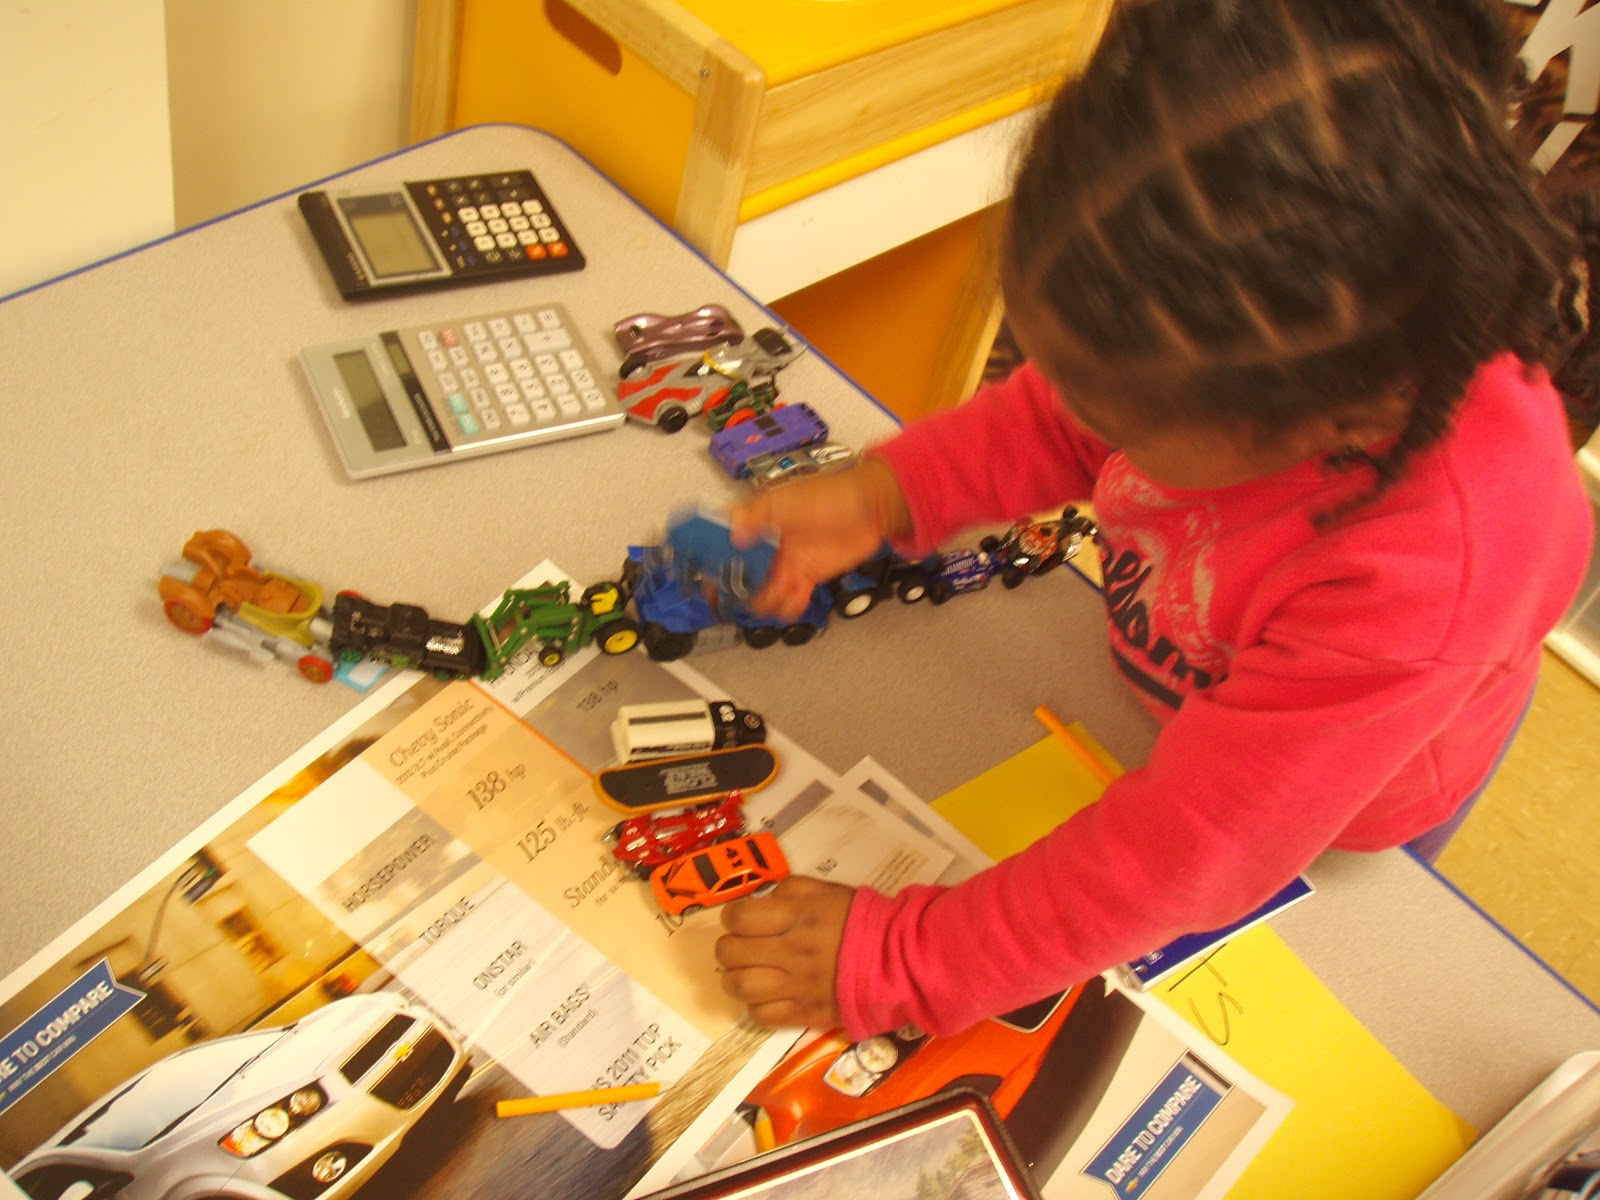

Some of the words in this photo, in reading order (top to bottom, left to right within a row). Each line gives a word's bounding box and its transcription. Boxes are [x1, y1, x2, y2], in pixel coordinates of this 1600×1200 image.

[386, 723, 440, 772] Chevy
[430, 693, 476, 734] Sonic
[463, 768, 510, 812] 138
[502, 758, 530, 785] hp
[512, 818, 560, 863] 125
[814, 854, 839, 878] No
[341, 831, 436, 913] HORSEPOWER
[417, 895, 475, 948] TORQUE
[470, 937, 529, 992] ONSTAR
[10, 1038, 41, 1066] TO
[33, 978, 115, 1048] COMPARE
[526, 1017, 558, 1048] AIR
[596, 1064, 652, 1122] SATY
[644, 1034, 682, 1072] PICK
[604, 1045, 640, 1082] 2011
[631, 1021, 665, 1054] TOP
[1103, 1143, 1143, 1185] DARE
[1131, 1127, 1156, 1153] TO
[1145, 1074, 1202, 1137] COMPARE
